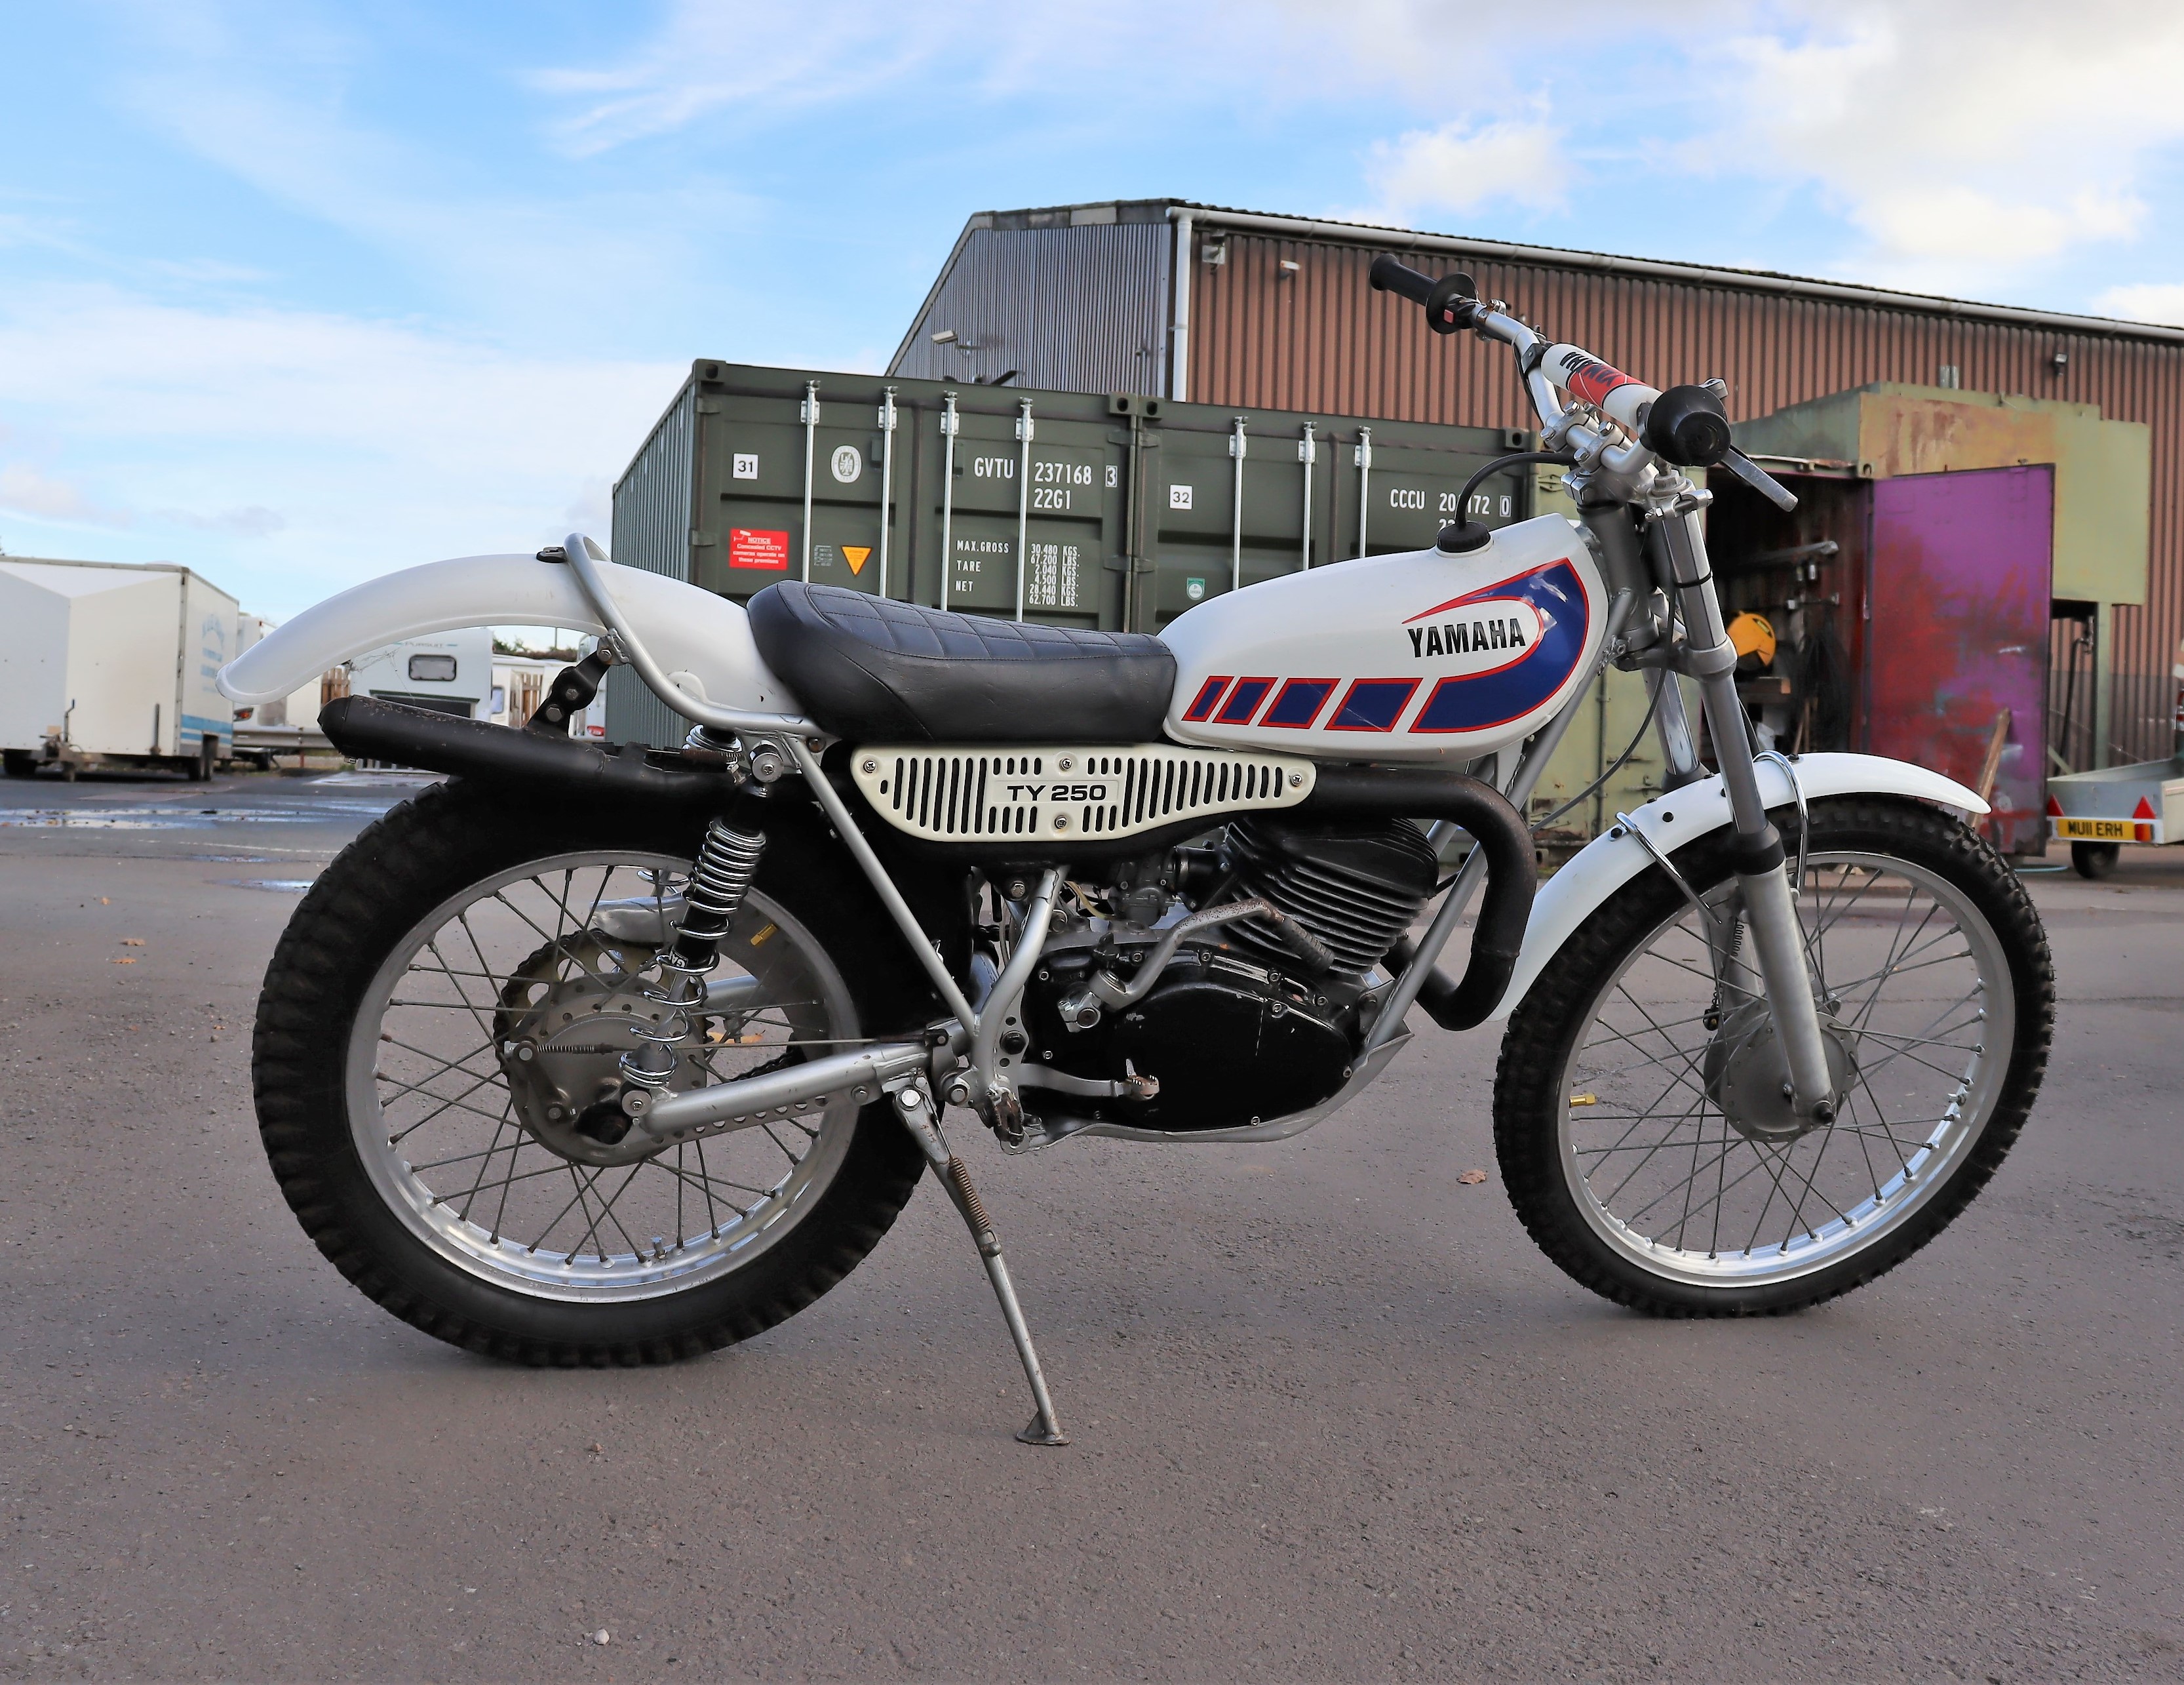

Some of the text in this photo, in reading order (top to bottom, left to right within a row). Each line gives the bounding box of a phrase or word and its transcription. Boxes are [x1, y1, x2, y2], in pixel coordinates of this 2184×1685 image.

[738, 461, 753, 472] 31
[974, 458, 1116, 486] GVTU 237168 3
[1034, 488, 1071, 510] 22G1
[1173, 492, 1189, 503] 32
[1390, 488, 1426, 509] CCCU
[1439, 493, 1491, 515] 20172
[956, 540, 1081, 557] MAX.GROSS 30.480 KGS.
[957, 560, 1080, 577] TARE 2.040 KGS.
[1030, 555, 1080, 566] 67.200 LBS.
[955, 580, 1079, 597] NET 28.440 KGS.
[1034, 574, 1080, 587] 4.500 LBS.
[1029, 595, 1079, 607] 62.700 LBS.
[1407, 618, 1526, 658] YAMAHA
[1007, 784, 1106, 801] TY 250
[2096, 822, 2123, 837] ERH
